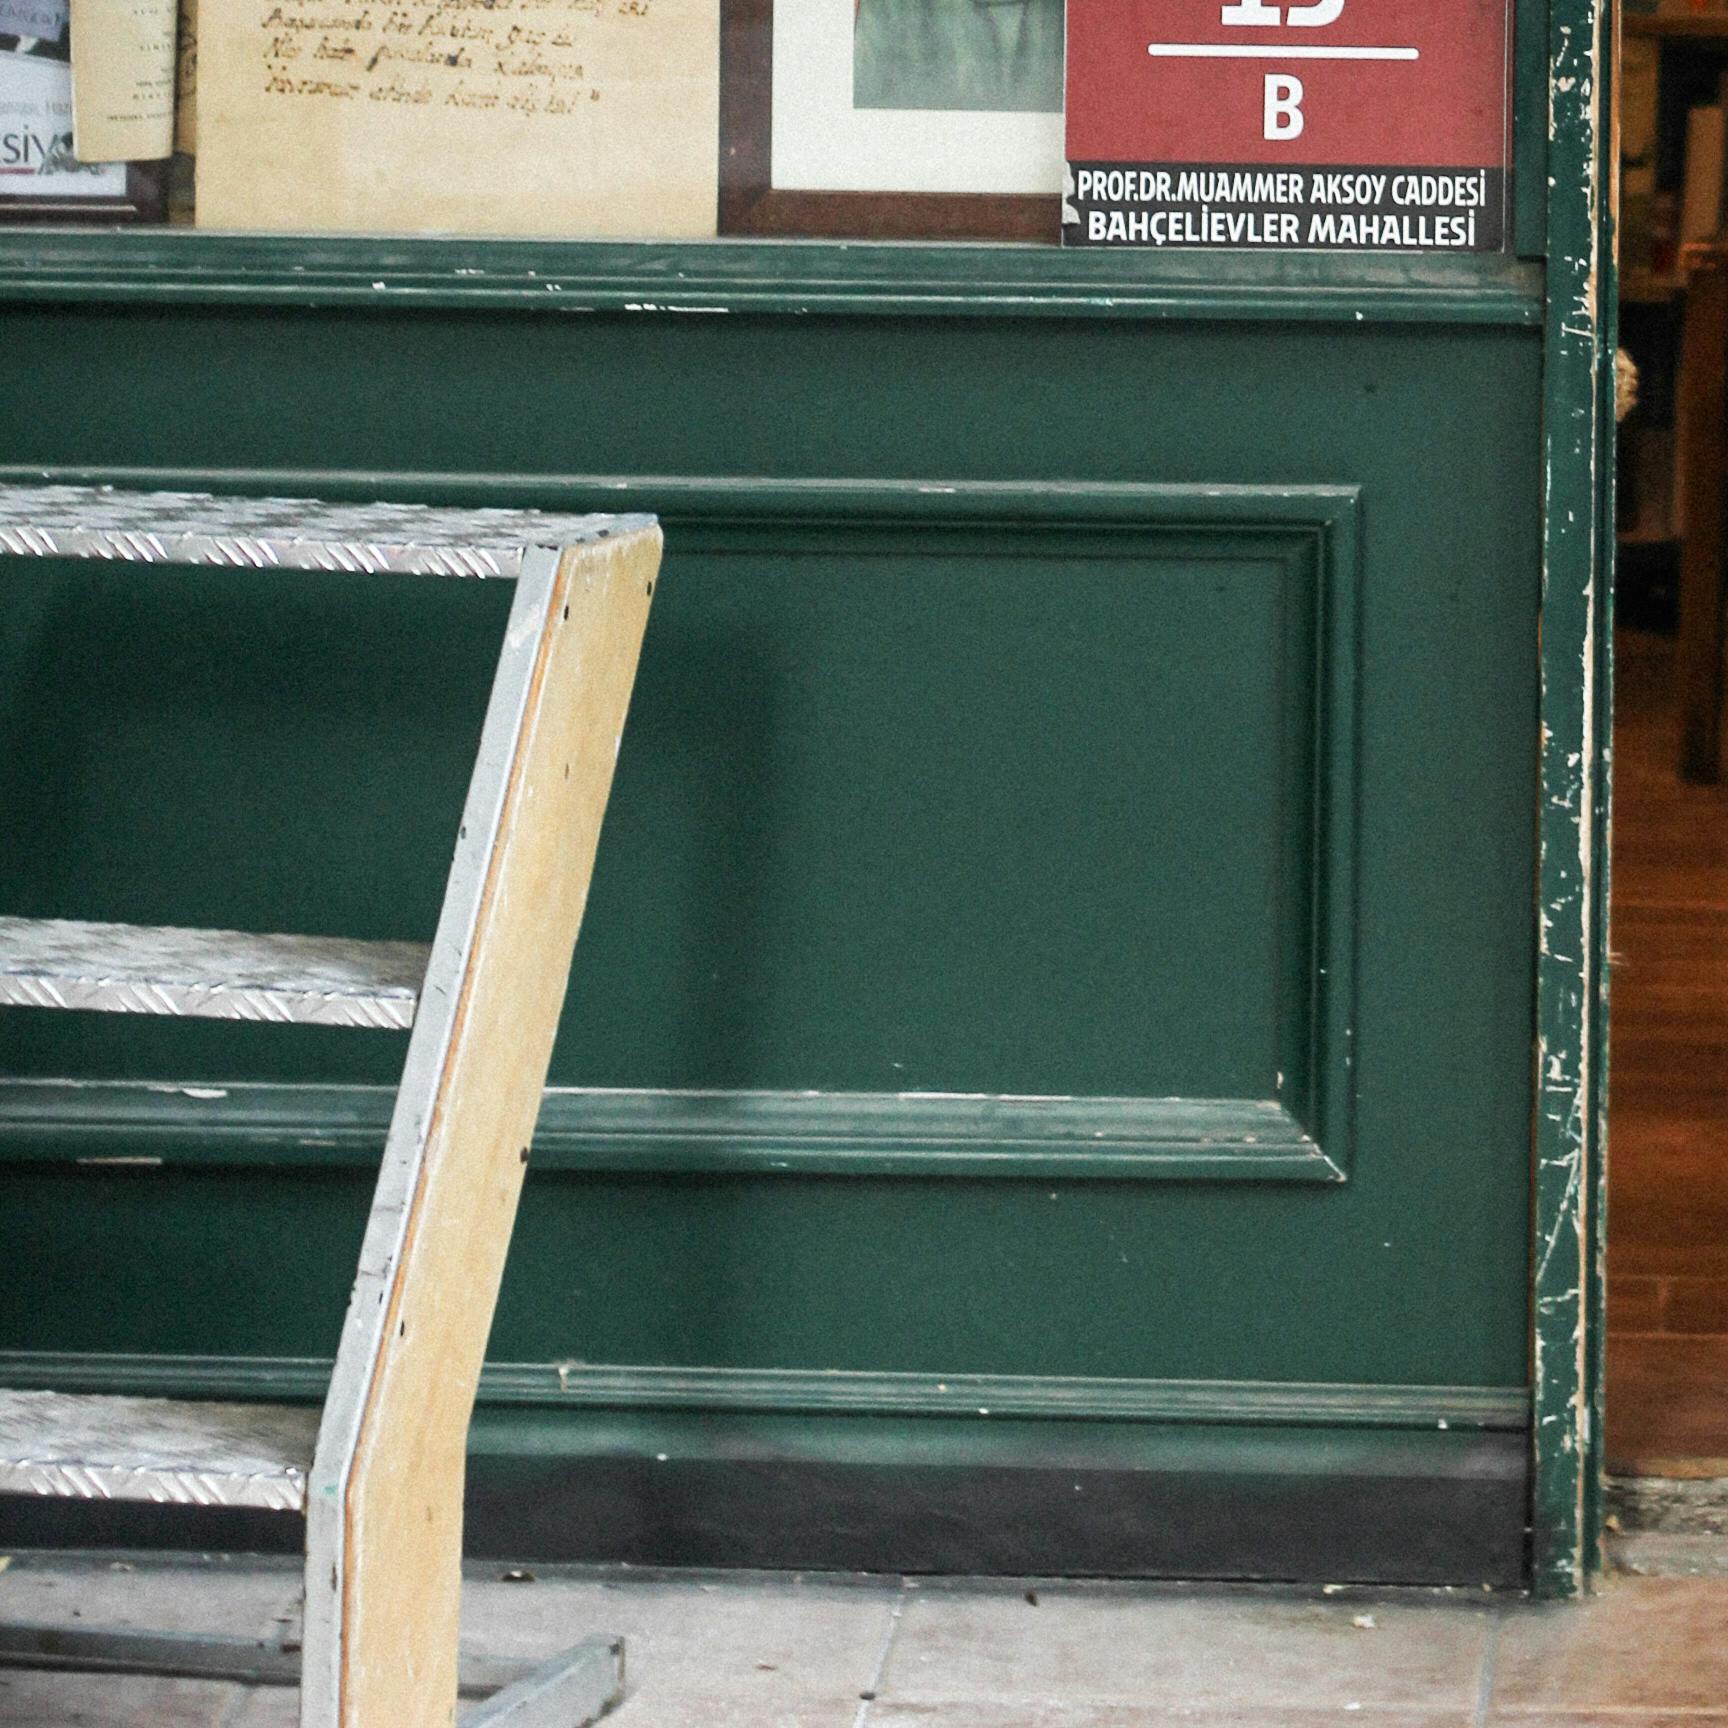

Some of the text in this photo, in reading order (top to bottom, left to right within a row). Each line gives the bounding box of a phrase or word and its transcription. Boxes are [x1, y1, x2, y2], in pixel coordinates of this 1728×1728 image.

[1262, 72, 1305, 142] B
[1077, 168, 1487, 208] PROF.DR.MUAMMER AKSOY CADDESİ
[1087, 203, 1476, 247] BAHÇELİEVLER MAHALLESİ
